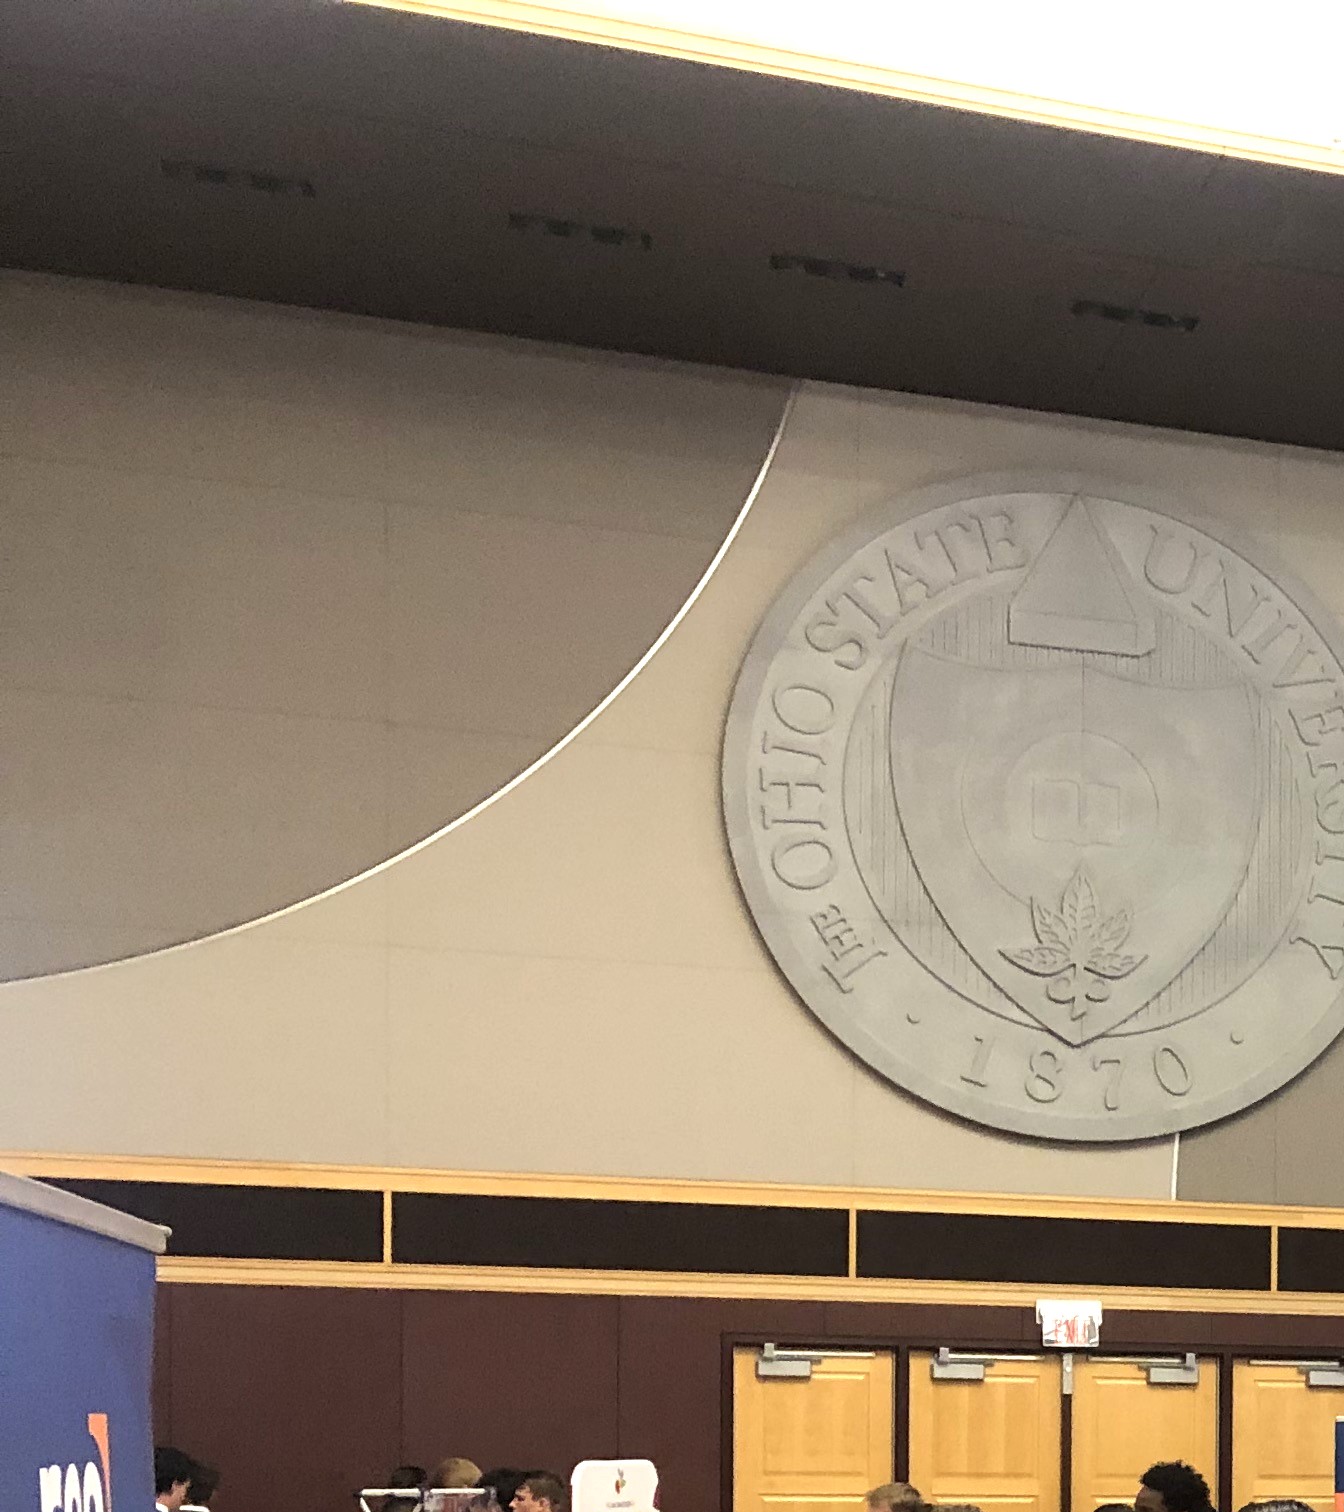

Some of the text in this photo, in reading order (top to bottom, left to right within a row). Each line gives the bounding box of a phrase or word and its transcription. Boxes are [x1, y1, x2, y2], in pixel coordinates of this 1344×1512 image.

[803, 508, 1032, 674] STATE
[757, 681, 836, 892] OHIO
[808, 901, 888, 996] THE
[960, 1034, 1194, 1111] 1870
